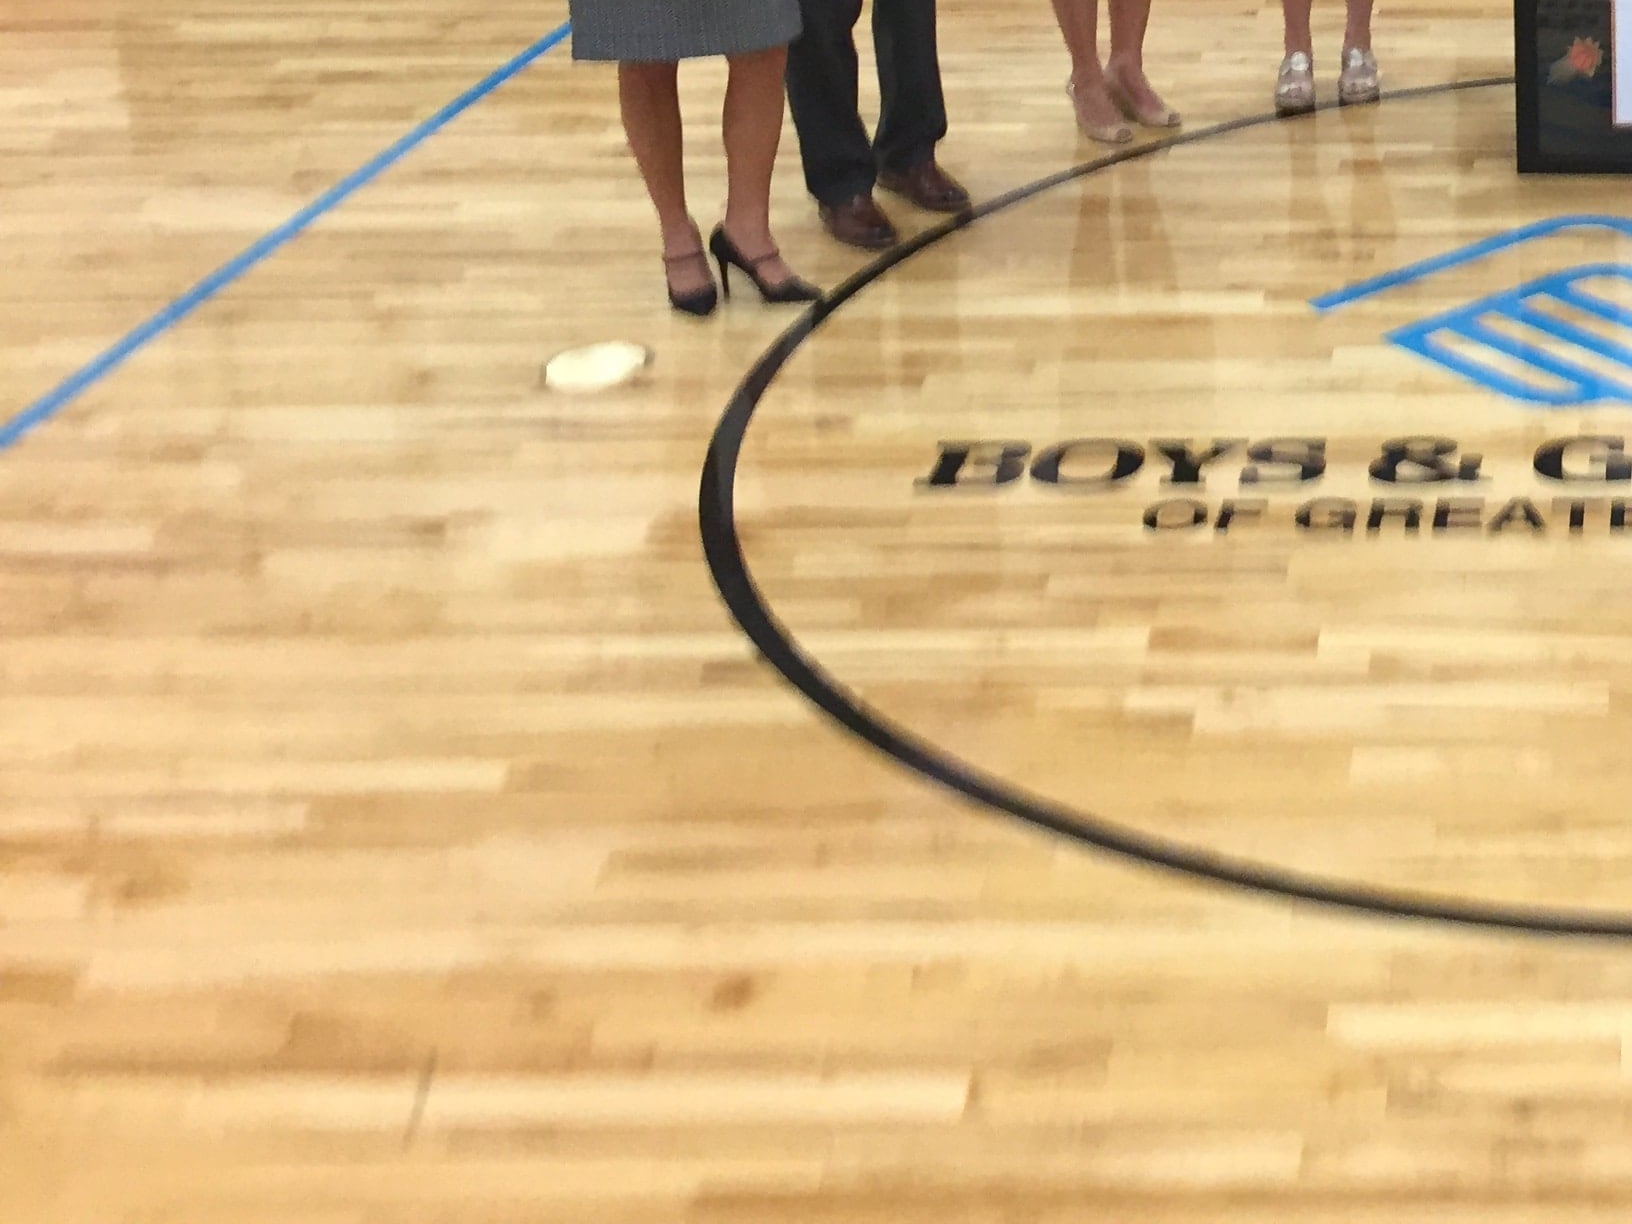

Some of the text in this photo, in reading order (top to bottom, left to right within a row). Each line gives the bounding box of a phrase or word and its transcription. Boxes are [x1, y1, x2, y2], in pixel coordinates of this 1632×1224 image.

[913, 434, 1327, 492] BOYS
[1368, 433, 1490, 486] &
[1142, 497, 1268, 534] OF
